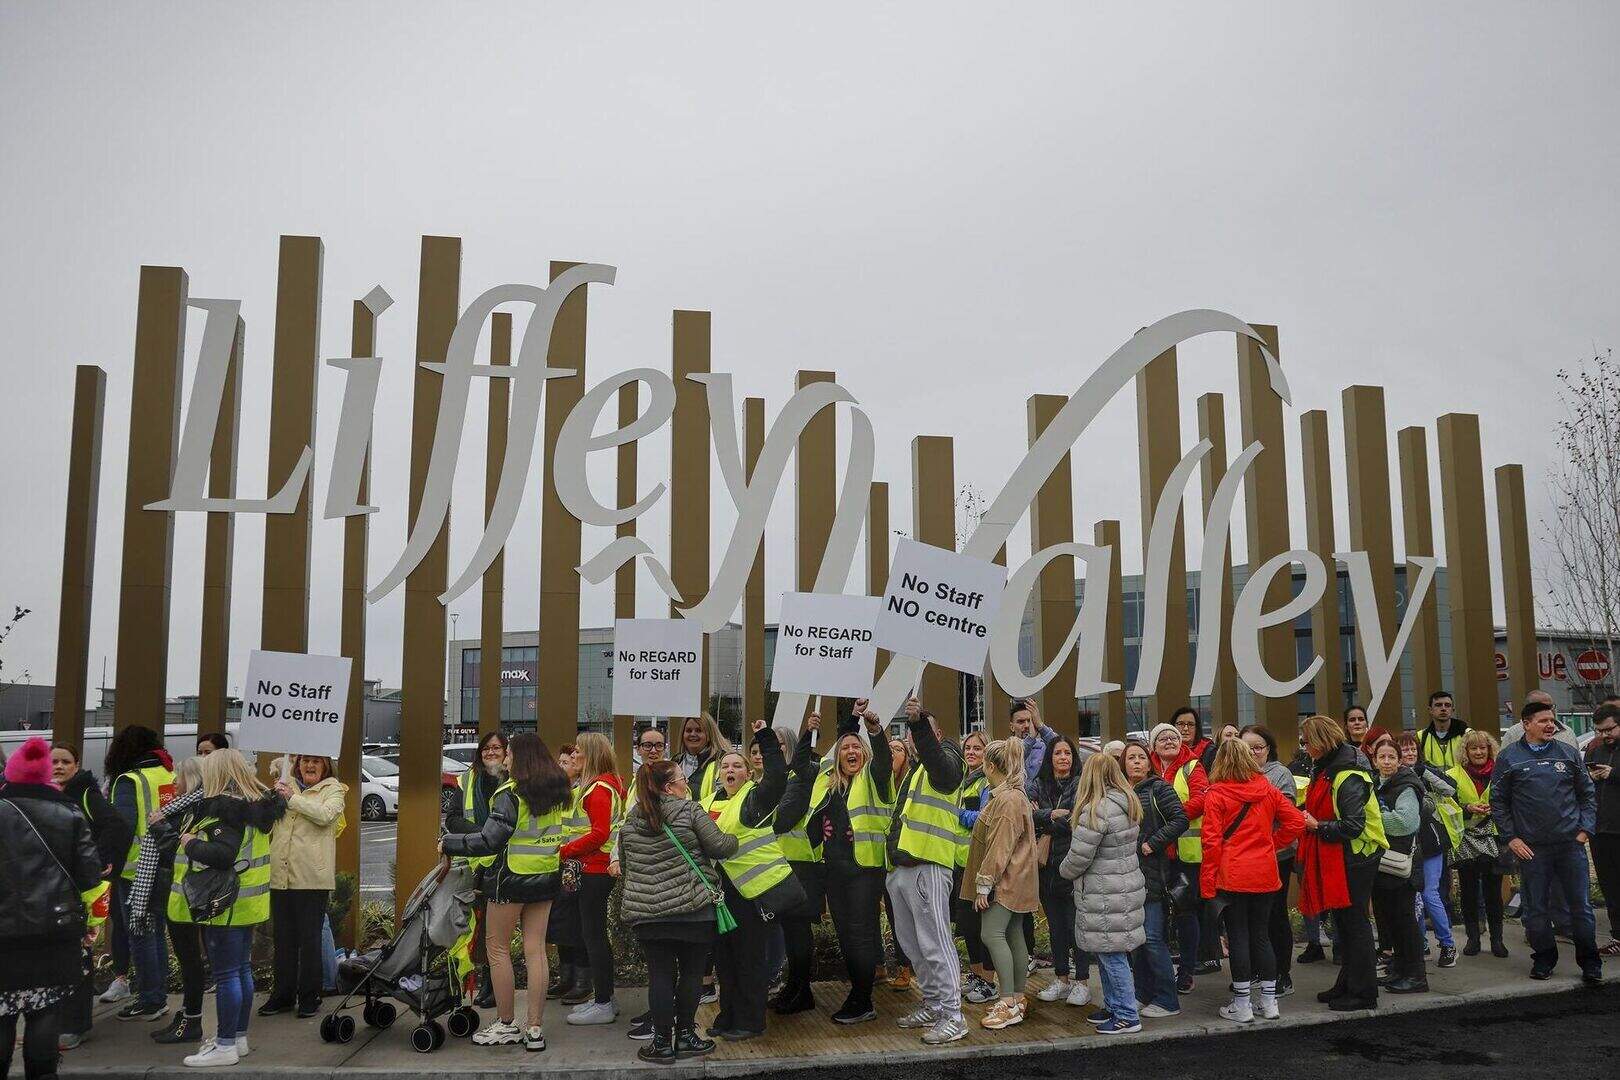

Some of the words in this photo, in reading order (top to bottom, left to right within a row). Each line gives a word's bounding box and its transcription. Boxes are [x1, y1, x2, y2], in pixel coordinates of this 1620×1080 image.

[143, 263, 864, 634] Liffey
[770, 308, 1437, 757] Valley
[901, 573, 929, 594] No
[934, 583, 984, 610] Staff
[887, 595, 920, 618] NO
[924, 610, 988, 638] centre
[783, 625, 803, 638] No
[807, 626, 873, 642] REGARD
[619, 650, 636, 663] No
[639, 651, 697, 663] REGARD
[794, 644, 815, 657] for
[819, 645, 853, 659] Staff
[629, 668, 647, 680] for
[650, 668, 681, 681] Staff
[1537, 652, 1567, 681] ue
[257, 680, 283, 696] No
[288, 682, 332, 700] Staff
[248, 702, 276, 718] NO
[281, 708, 339, 724] centre
